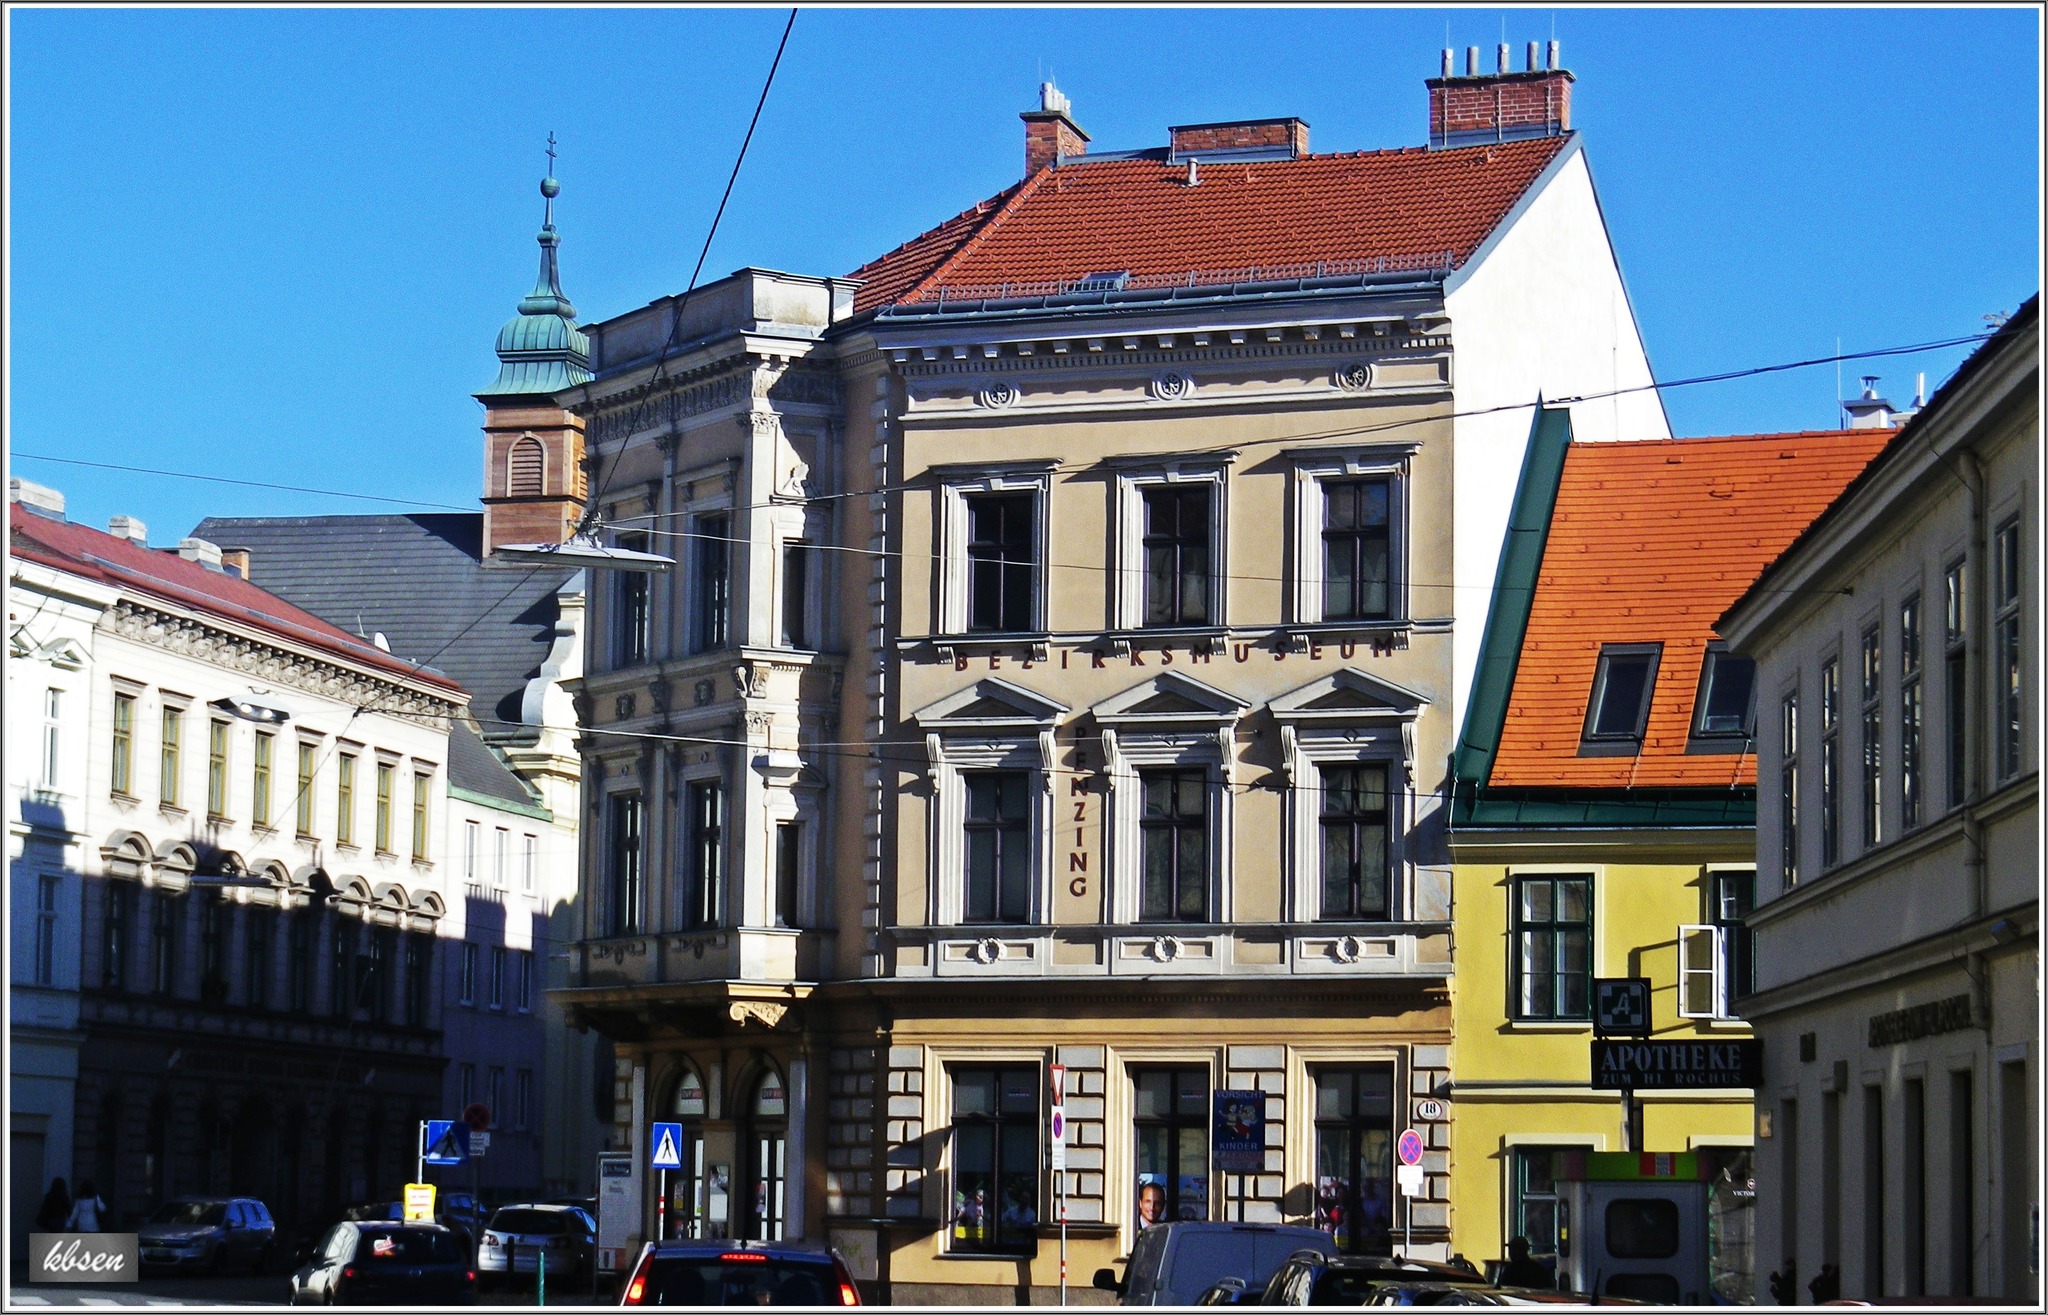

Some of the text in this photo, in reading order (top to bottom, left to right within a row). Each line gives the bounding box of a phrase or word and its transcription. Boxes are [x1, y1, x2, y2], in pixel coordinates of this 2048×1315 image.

[954, 636, 1393, 672] BEZIRKSMUSEUM
[1069, 727, 1089, 898] PENZING
[1601, 1044, 1742, 1072] APOTHEKE
[1602, 1073, 1632, 1085] ZUM
[1675, 1073, 1742, 1085] ROCHUS
[1215, 1090, 1263, 1099] VORSICHT
[1425, 1102, 1436, 1114] 18
[1219, 1142, 1258, 1150] KINDER
